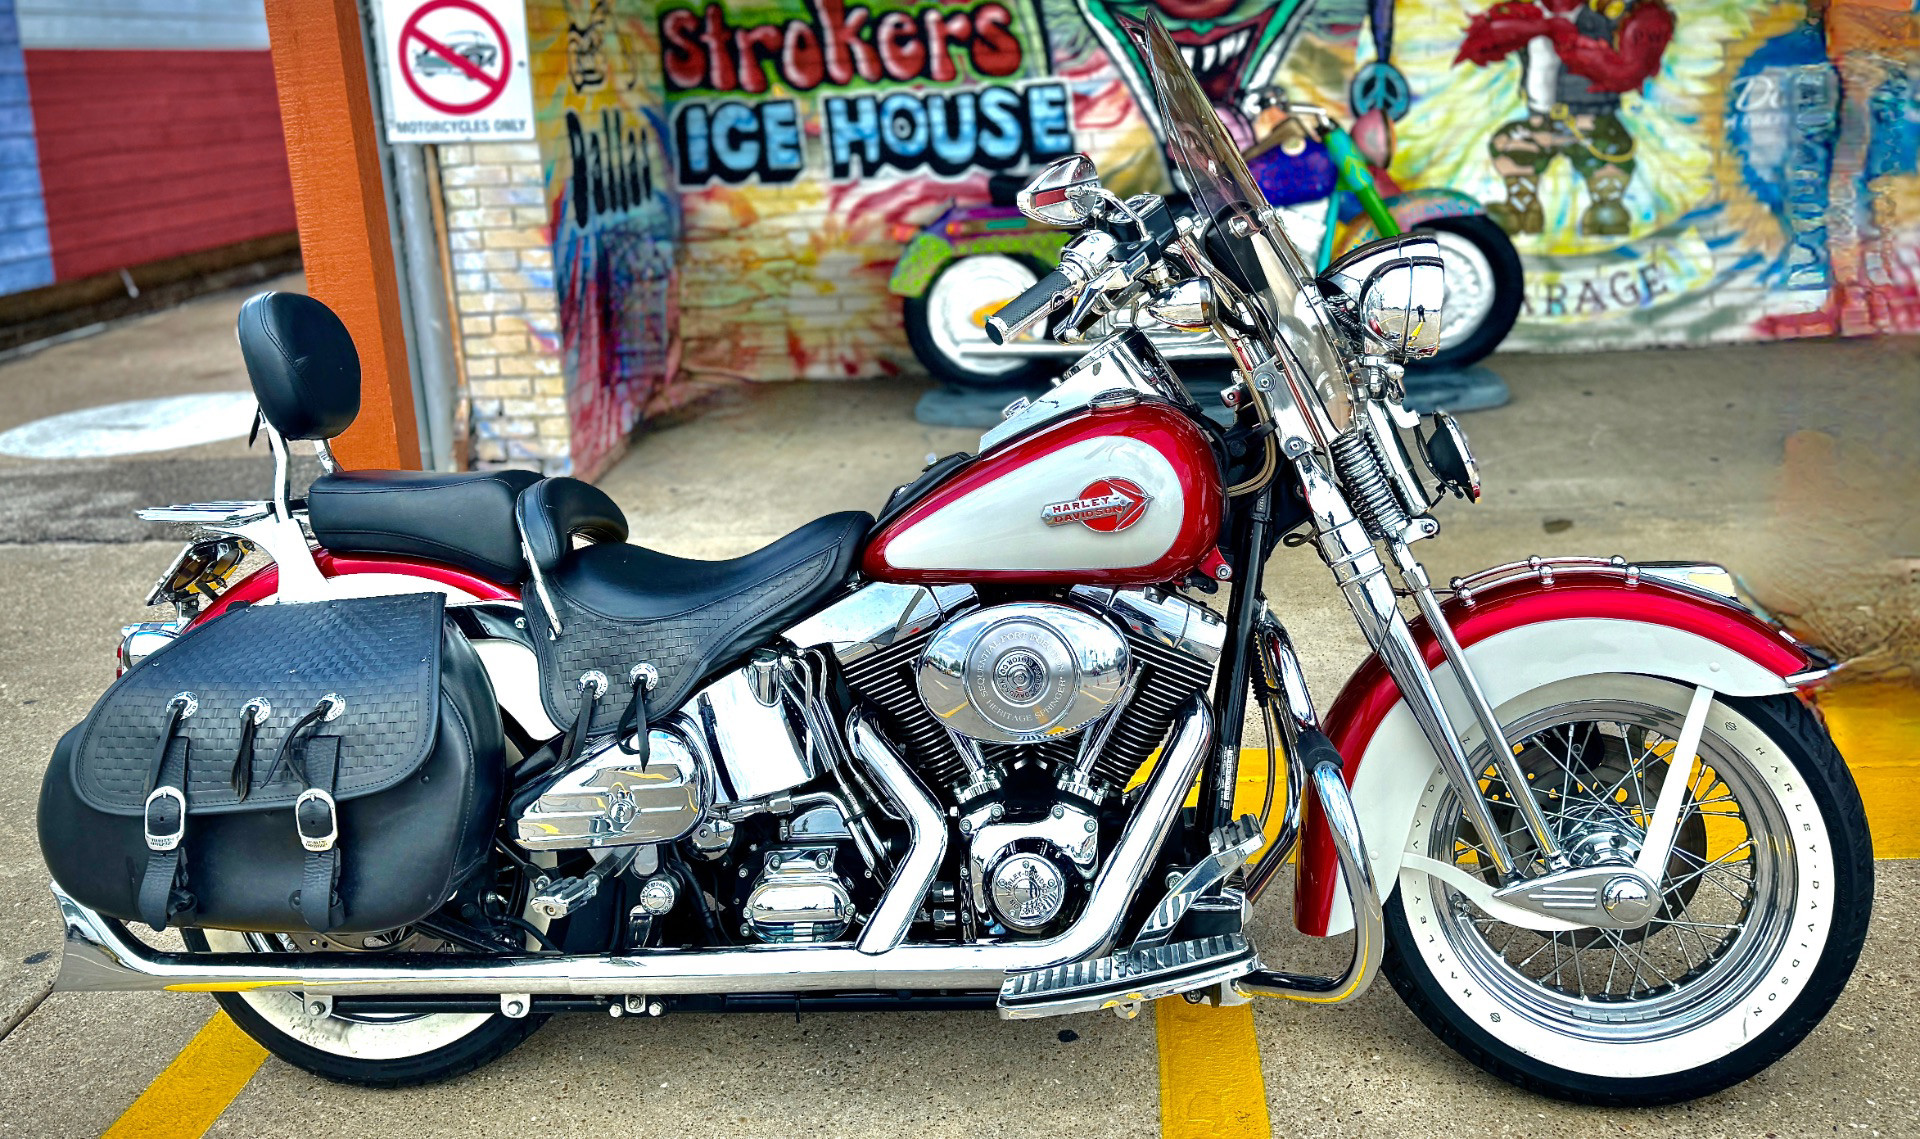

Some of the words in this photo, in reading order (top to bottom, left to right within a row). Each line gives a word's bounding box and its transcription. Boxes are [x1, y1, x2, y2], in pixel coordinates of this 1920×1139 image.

[661, 0, 1024, 92] Strokers
[396, 120, 490, 134] MOTORCYCLES
[494, 118, 526, 132] ONLY
[680, 101, 802, 182] ICE
[824, 83, 1074, 179] HOUSE
[1053, 505, 1123, 523] DAVIDSON
[977, 640, 999, 697] SEQUENTIAL
[1001, 631, 1027, 643] PORT
[986, 699, 1033, 721] HERITAGE
